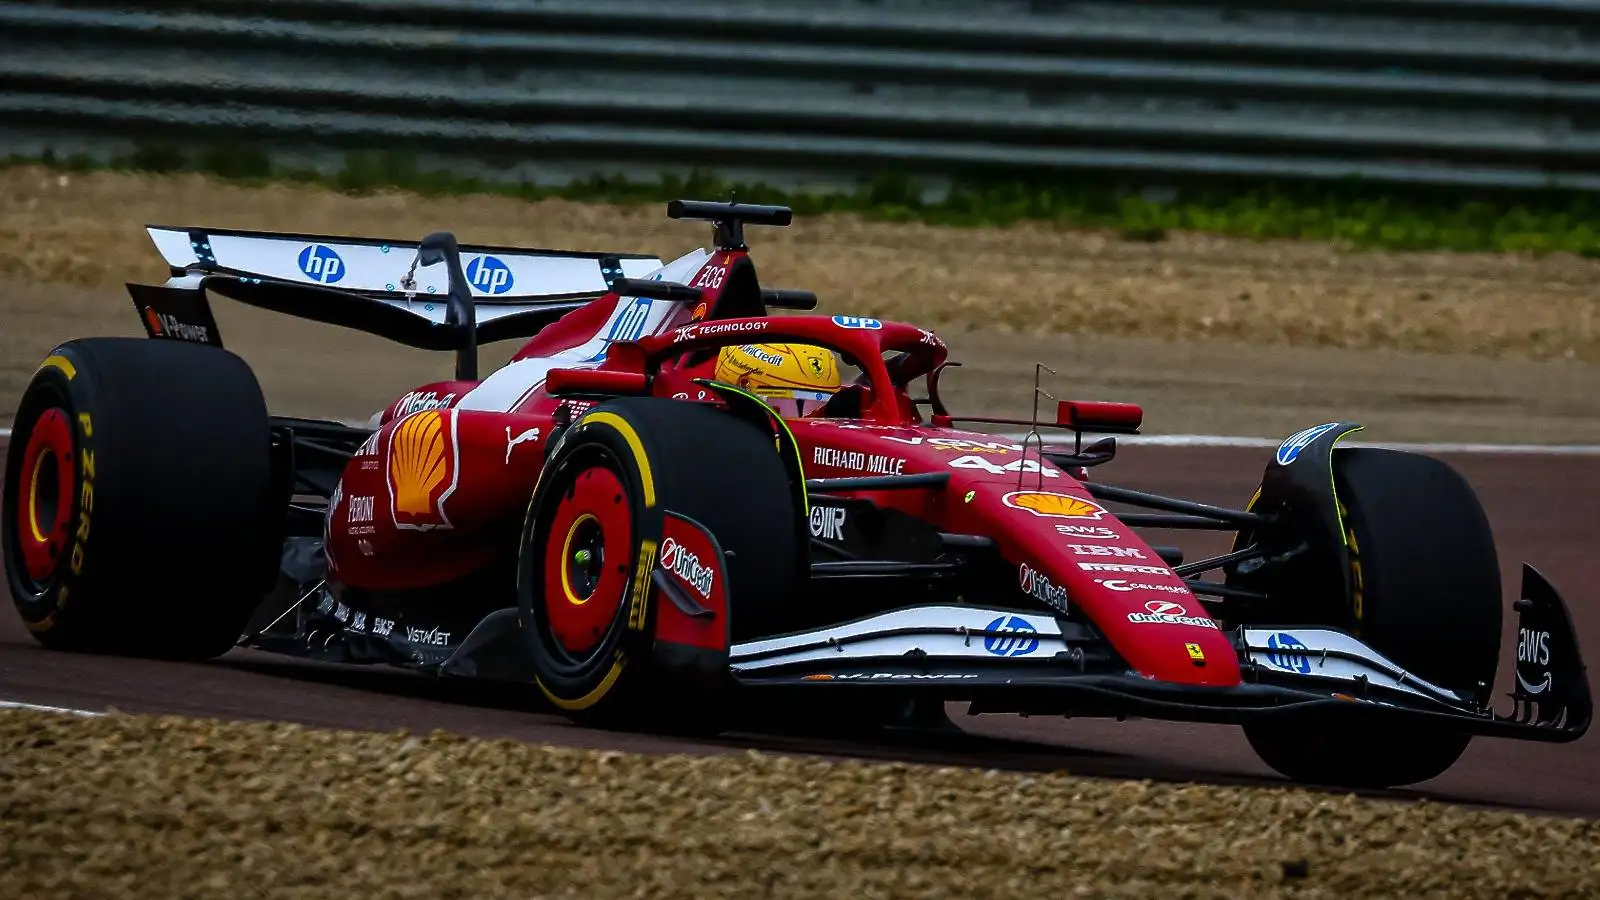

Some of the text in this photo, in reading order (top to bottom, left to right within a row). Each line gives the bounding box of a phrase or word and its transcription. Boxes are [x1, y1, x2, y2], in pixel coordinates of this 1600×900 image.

[302, 245, 341, 283] hp
[471, 257, 509, 294] hp
[700, 322, 769, 335] TECHNOLOGY
[813, 447, 907, 477] RICHARD MILLE
[947, 455, 1060, 478] 44
[70, 412, 96, 575] P ZERO
[1055, 524, 1114, 535] aws
[1067, 544, 1147, 559] IBM
[674, 545, 714, 600] UniCredit
[1030, 569, 1069, 616] UniCredit
[987, 615, 1036, 656] hp
[1127, 612, 1218, 630] UniCredit
[1271, 632, 1308, 672] hp
[1517, 627, 1551, 666] aws
